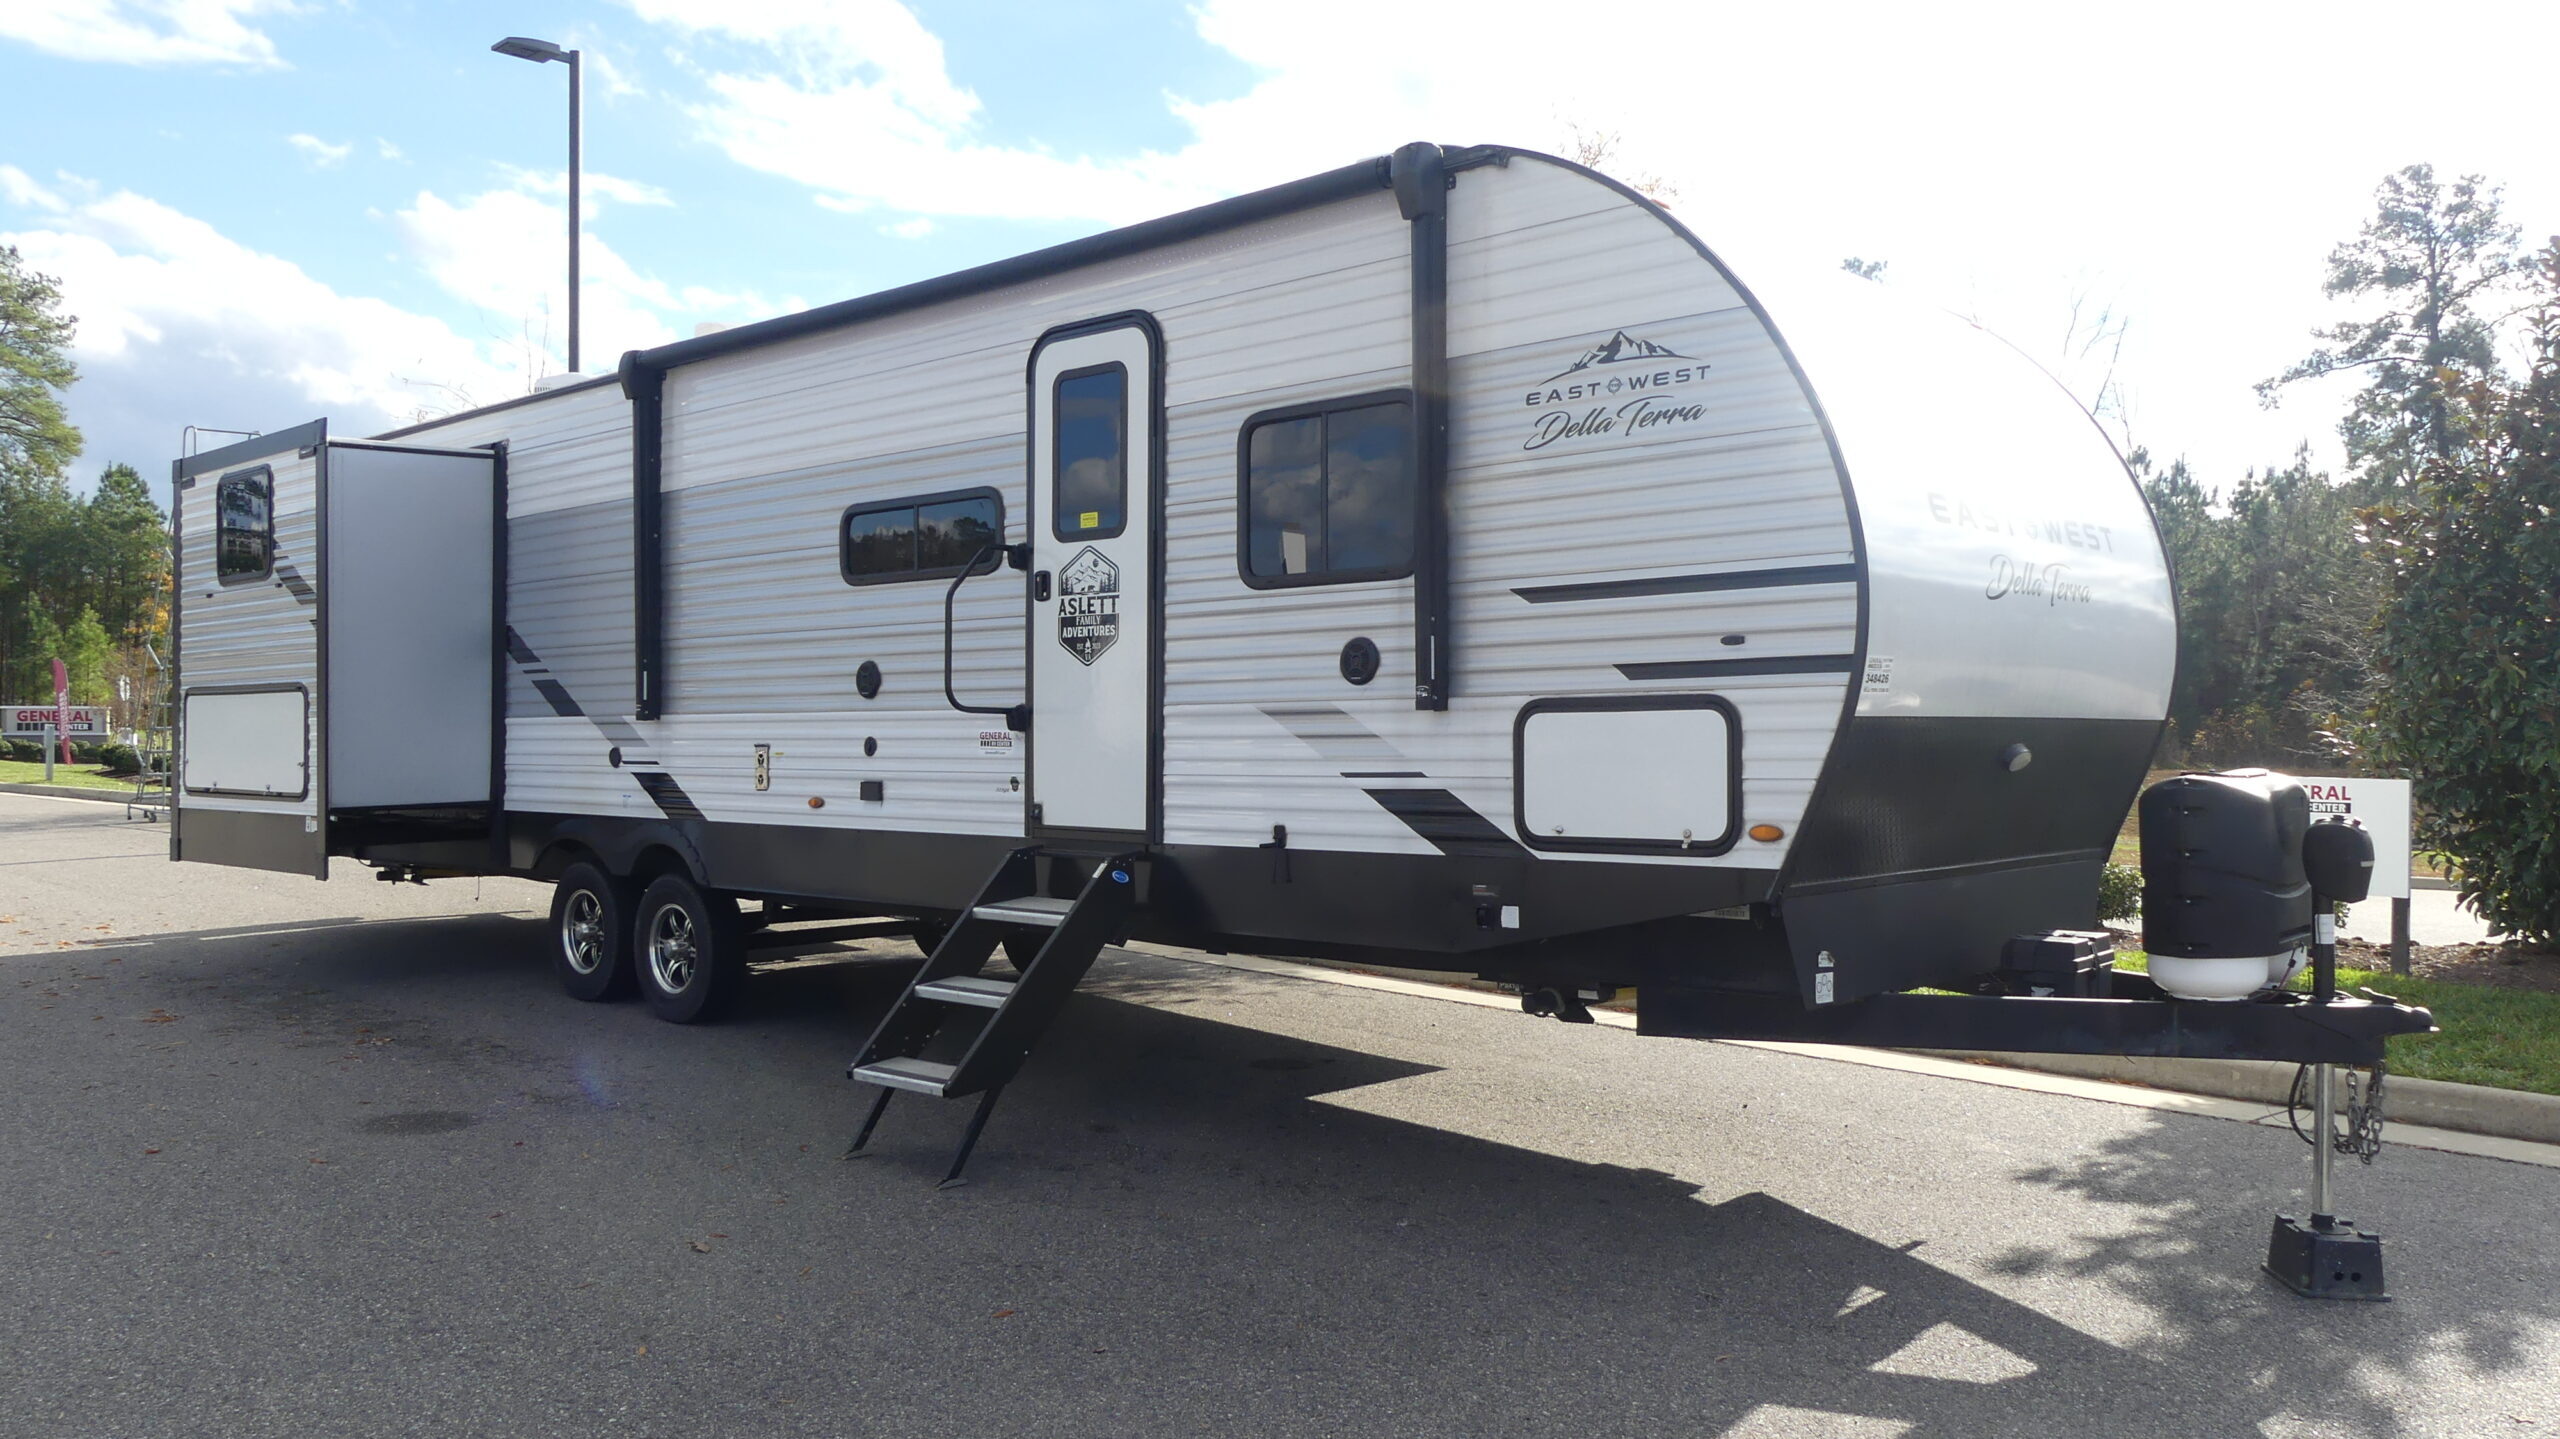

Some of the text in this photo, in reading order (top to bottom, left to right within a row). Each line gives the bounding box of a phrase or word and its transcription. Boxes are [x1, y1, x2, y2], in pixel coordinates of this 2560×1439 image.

[1525, 365, 1711, 406] EAST WEST
[1523, 395, 1706, 450] Della Terra
[2042, 520, 2113, 552] WEST
[1986, 554, 2091, 607] Della Terra
[1058, 595, 1120, 616] ASLETT
[1062, 625, 1116, 638] ADVENTURES
[1076, 616, 1101, 625] FAMILY
[979, 731, 1012, 740] GENERAL
